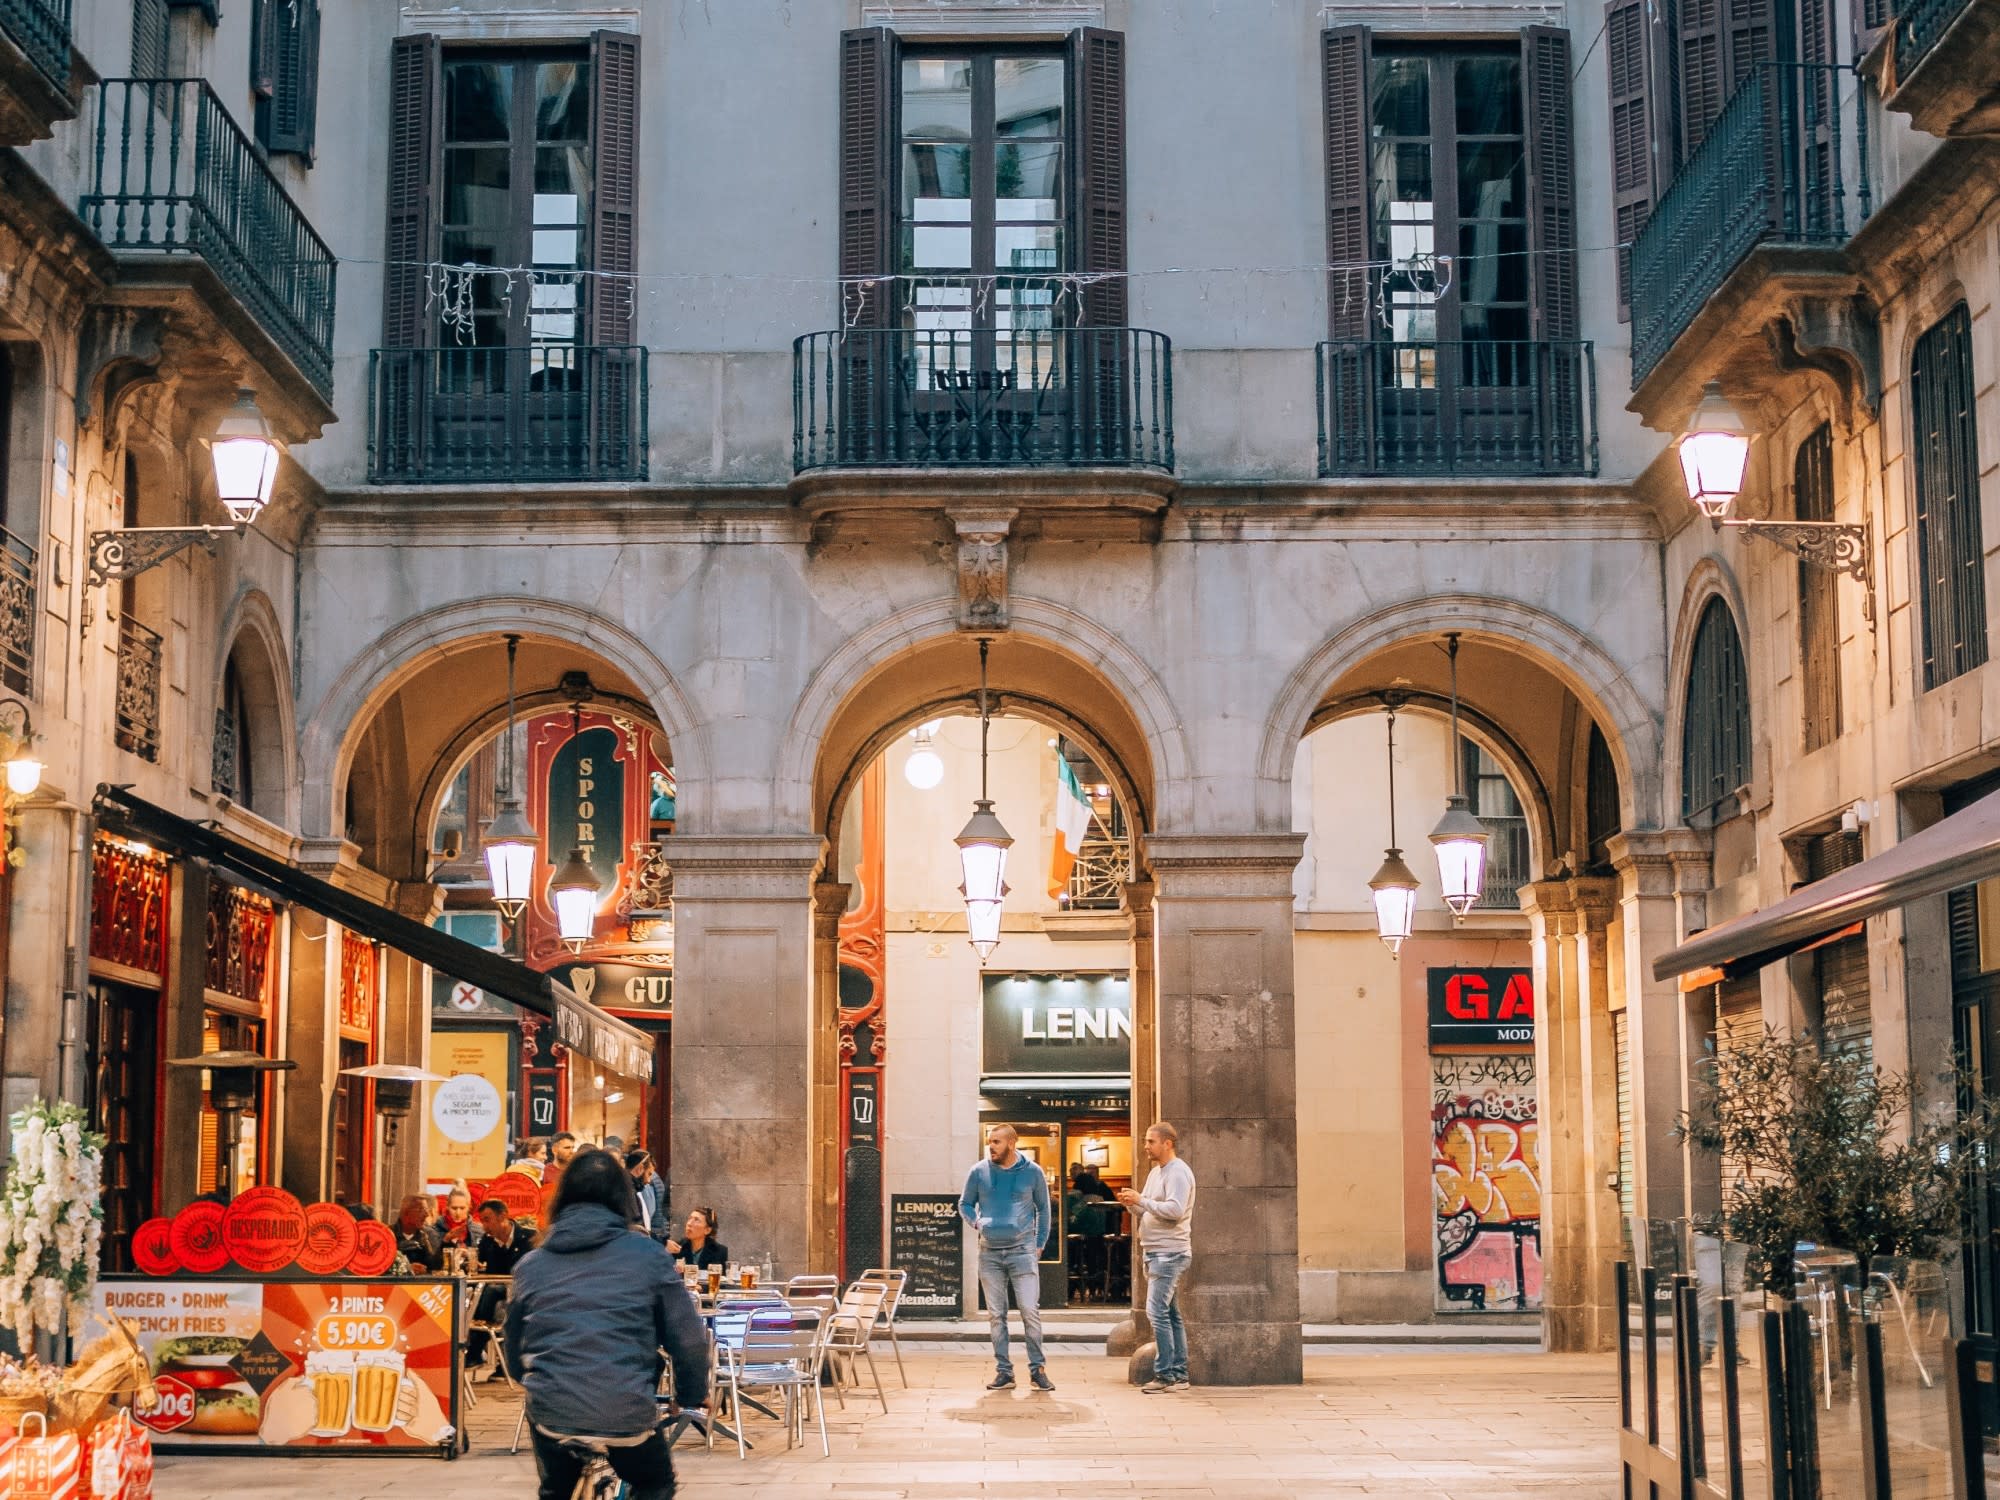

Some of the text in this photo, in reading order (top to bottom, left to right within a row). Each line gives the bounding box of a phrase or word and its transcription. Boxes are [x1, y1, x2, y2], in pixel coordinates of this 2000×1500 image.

[577, 757, 595, 870] SPORT
[625, 975, 672, 1004] GU
[1445, 974, 1535, 1020] GA
[1022, 1007, 1131, 1039] LENN
[896, 1202, 954, 1213] LENNOX
[230, 1218, 300, 1241] DESPERADOS
[105, 1292, 165, 1308] BURGER
[182, 1293, 229, 1308] DRINK
[330, 1297, 384, 1313] 2 PINTS
[418, 1291, 444, 1317] DAY!
[430, 1284, 453, 1304] ALL
[121, 1316, 178, 1333] ENCH
[183, 1316, 226, 1333] FRIES
[327, 1321, 385, 1346] 5,90€
[257, 1366, 279, 1376] BAR
